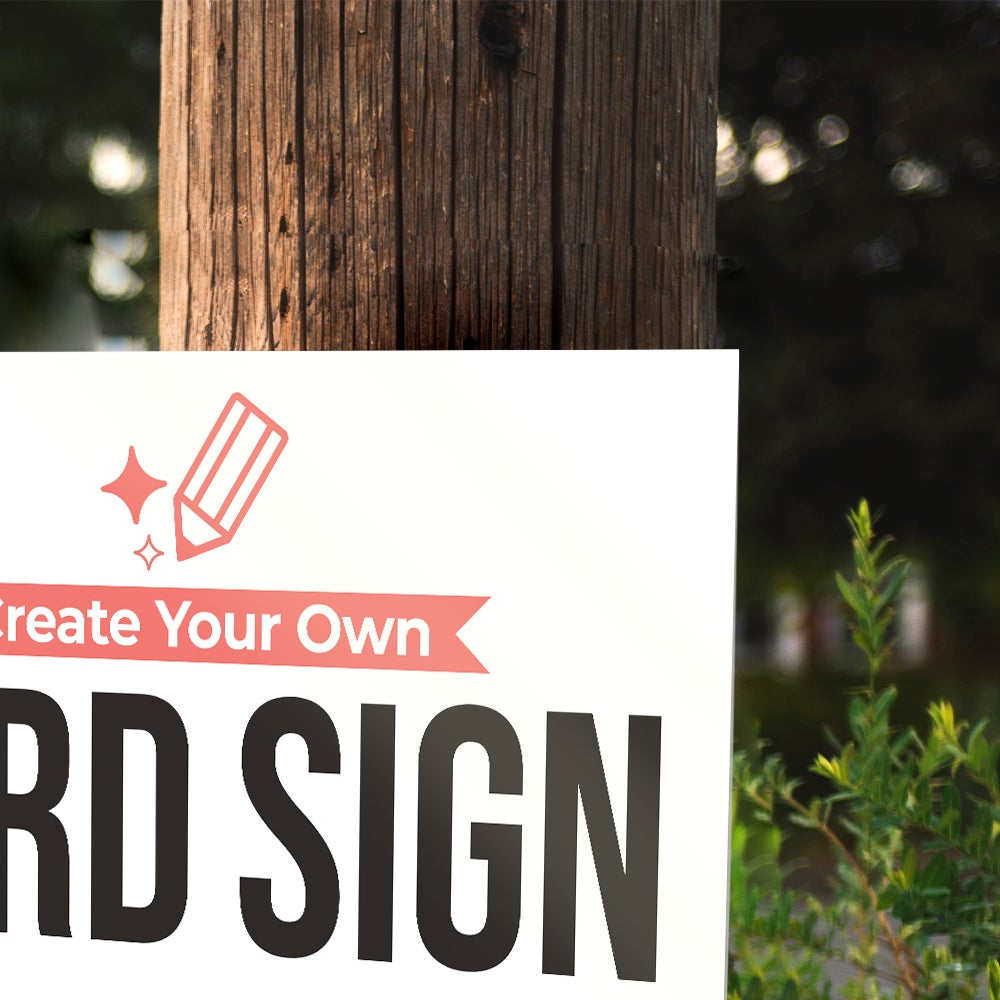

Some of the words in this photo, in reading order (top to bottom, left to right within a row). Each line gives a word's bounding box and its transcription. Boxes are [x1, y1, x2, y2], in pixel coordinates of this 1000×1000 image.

[158, 600, 281, 651] Your
[296, 603, 431, 657] Own
[240, 696, 663, 983] SIGN
